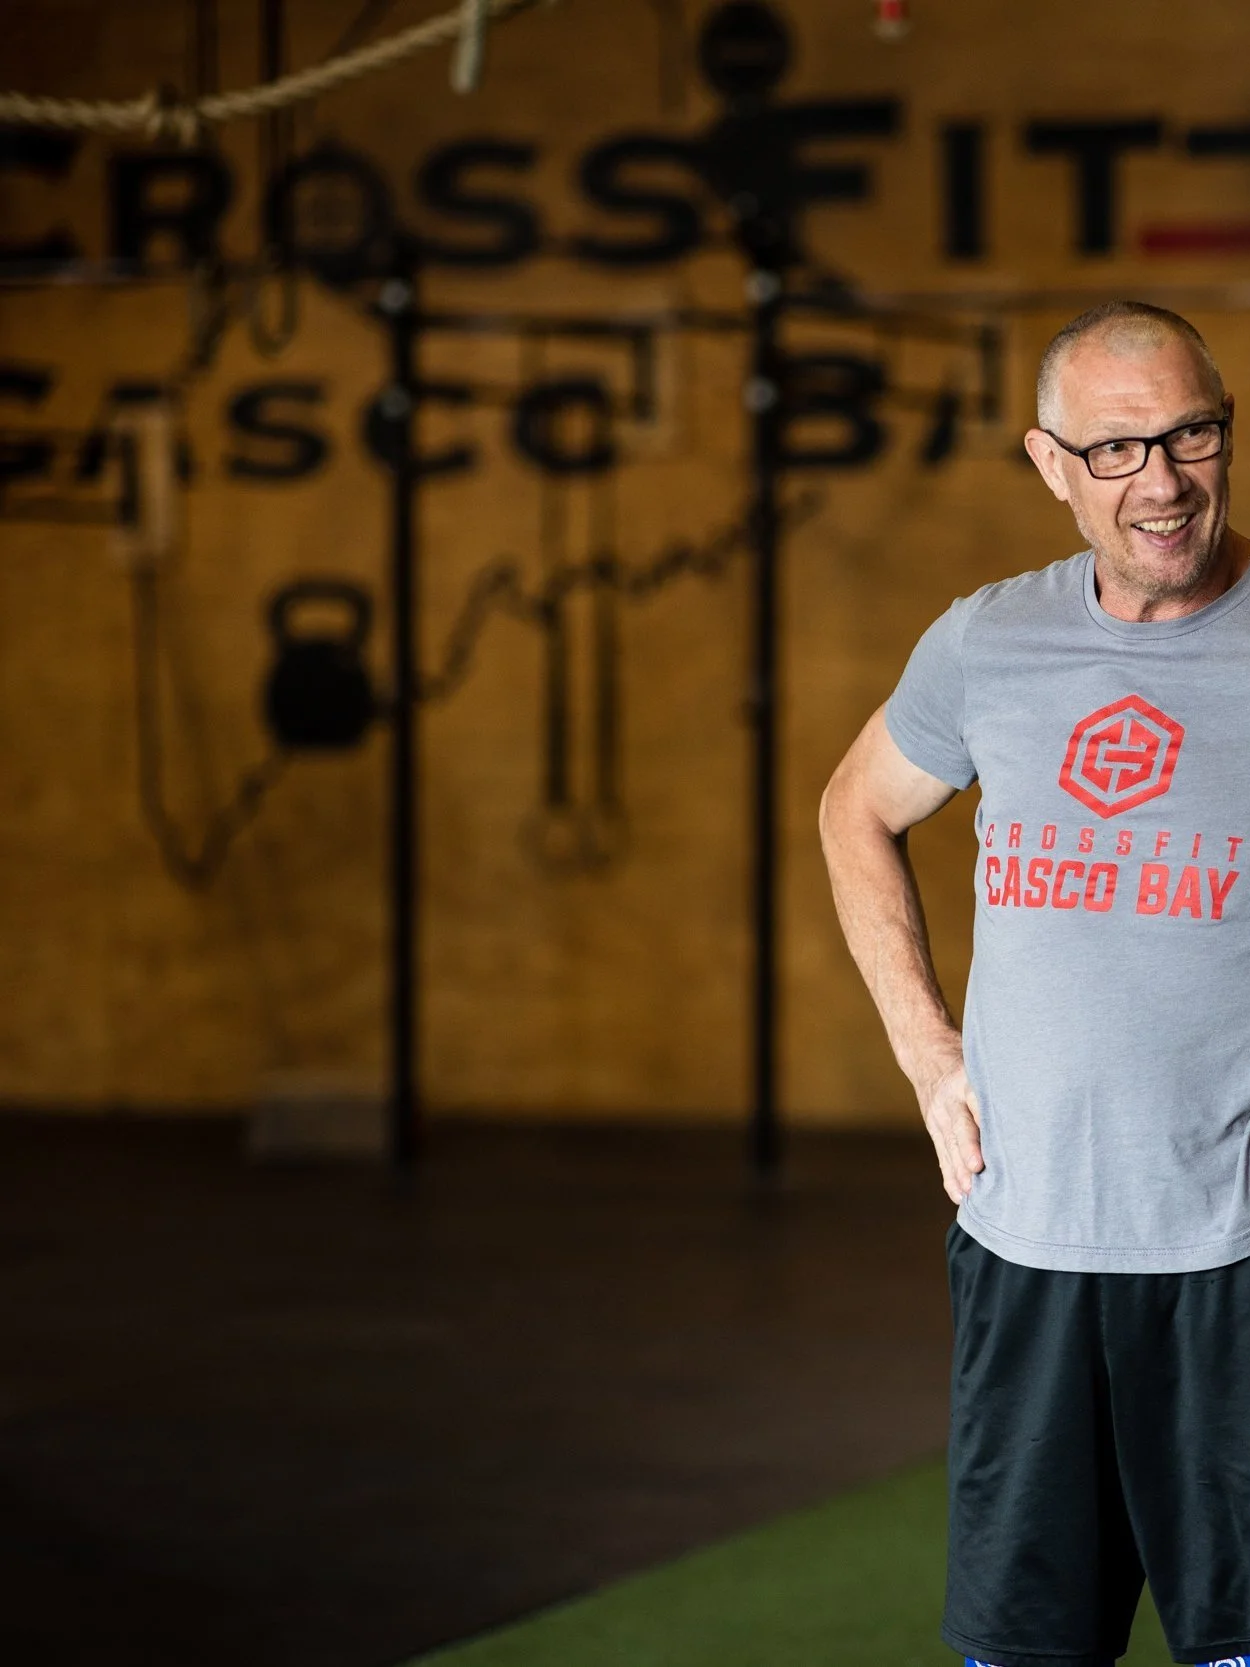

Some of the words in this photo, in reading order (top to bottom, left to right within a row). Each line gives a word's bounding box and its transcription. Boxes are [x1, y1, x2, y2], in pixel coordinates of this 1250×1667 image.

[0, 98, 1163, 274] CROSSFIT
[985, 822, 1243, 862] CROSSFIT
[985, 855, 1119, 912] CASCO
[1135, 862, 1240, 920] BAY
